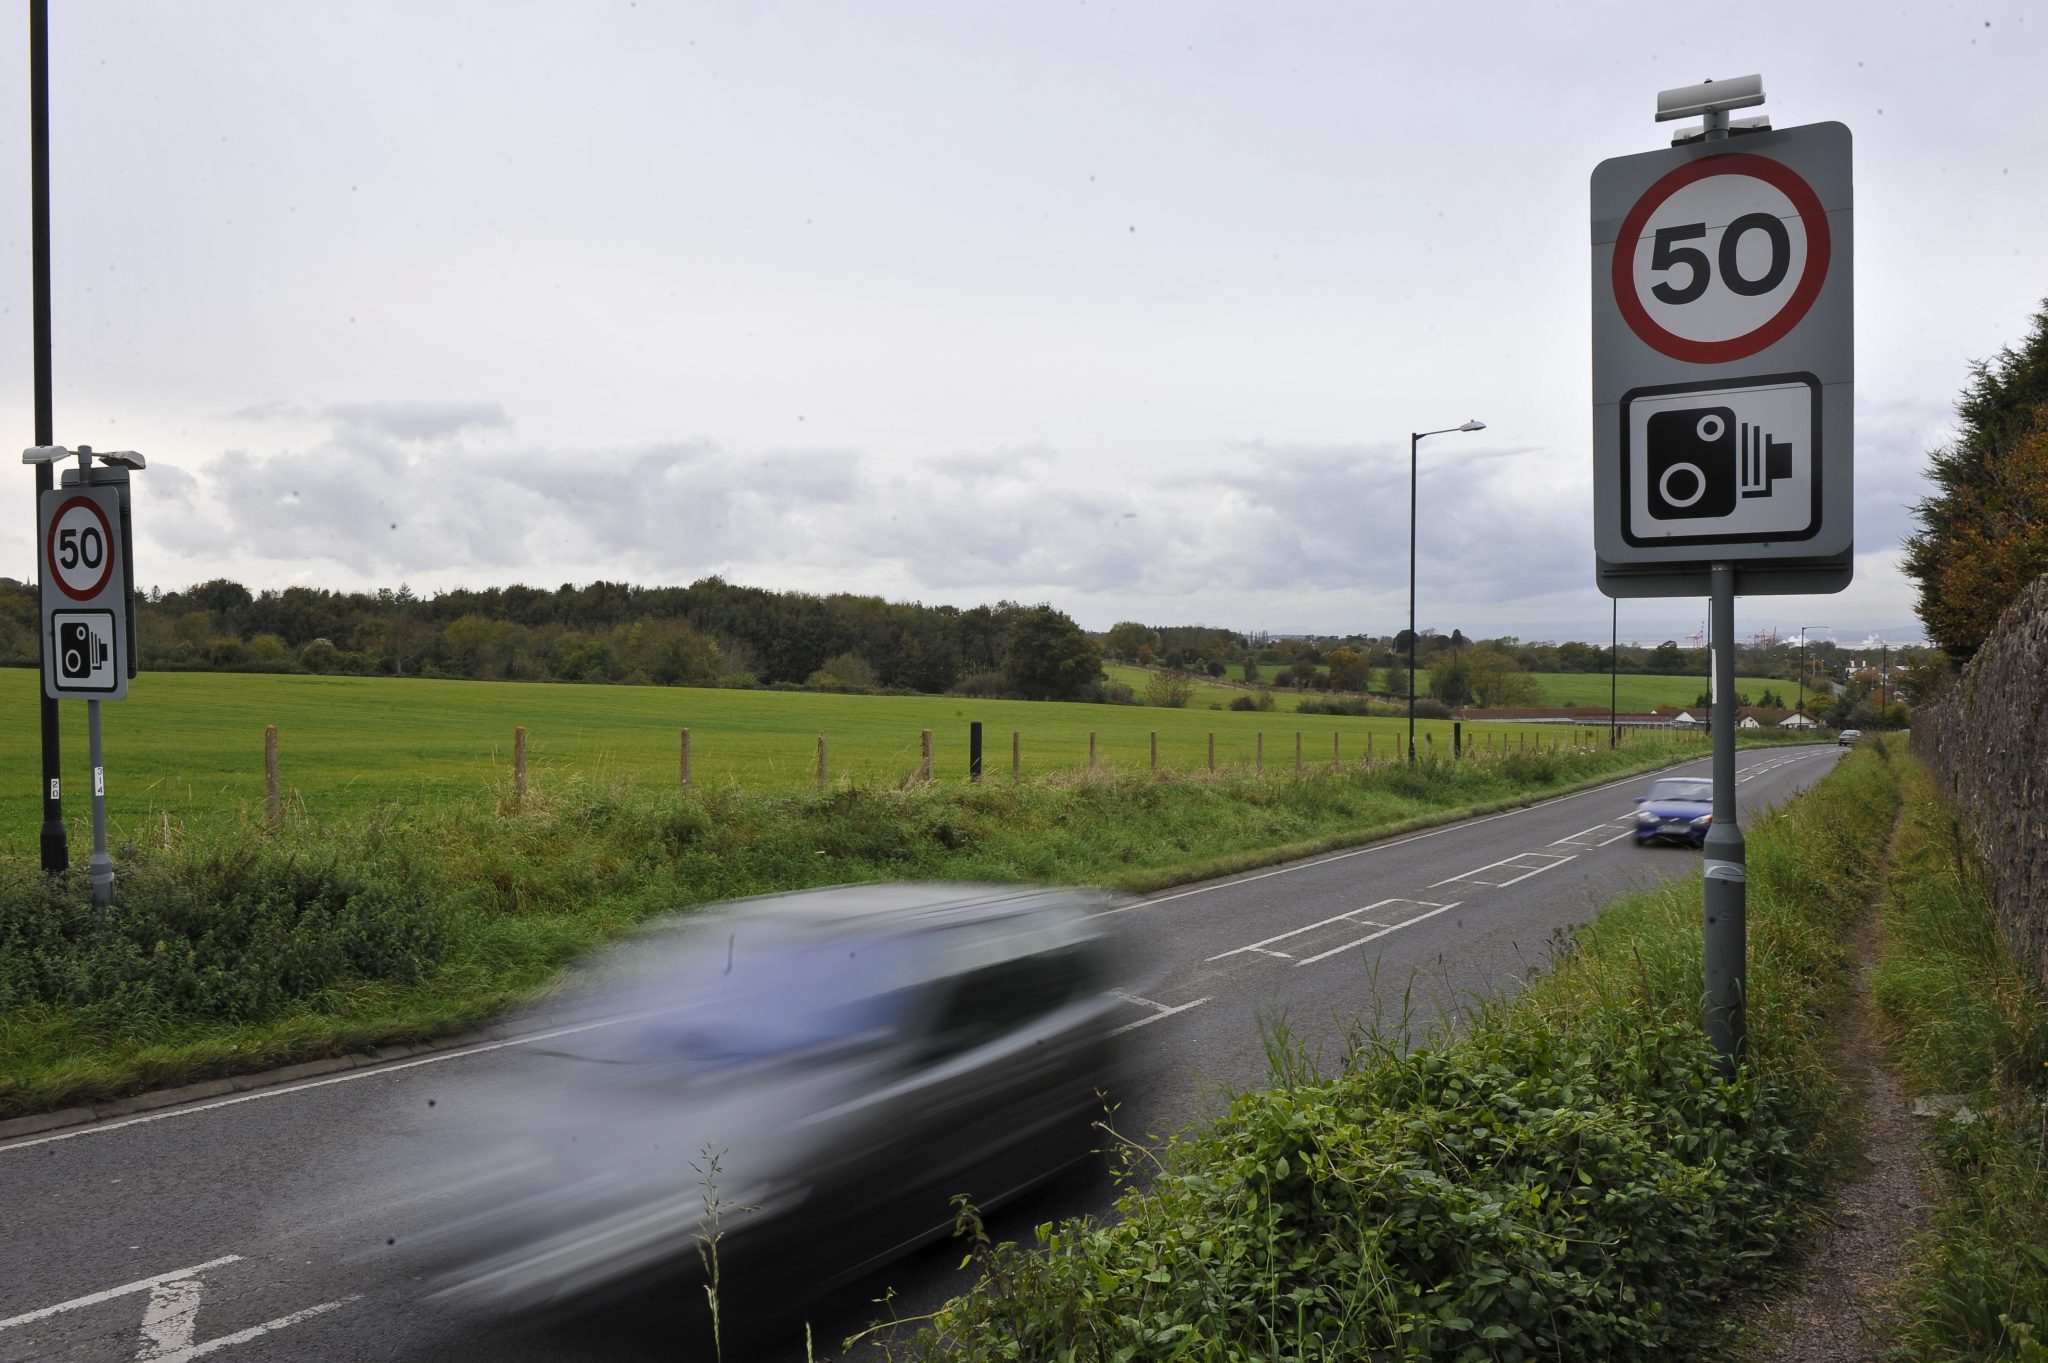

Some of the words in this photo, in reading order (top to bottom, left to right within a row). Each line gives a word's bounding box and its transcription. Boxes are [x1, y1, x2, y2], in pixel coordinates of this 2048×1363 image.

[1651, 212, 1791, 305] 50
[59, 526, 103, 570] 50
[52, 780, 59, 798] 20
